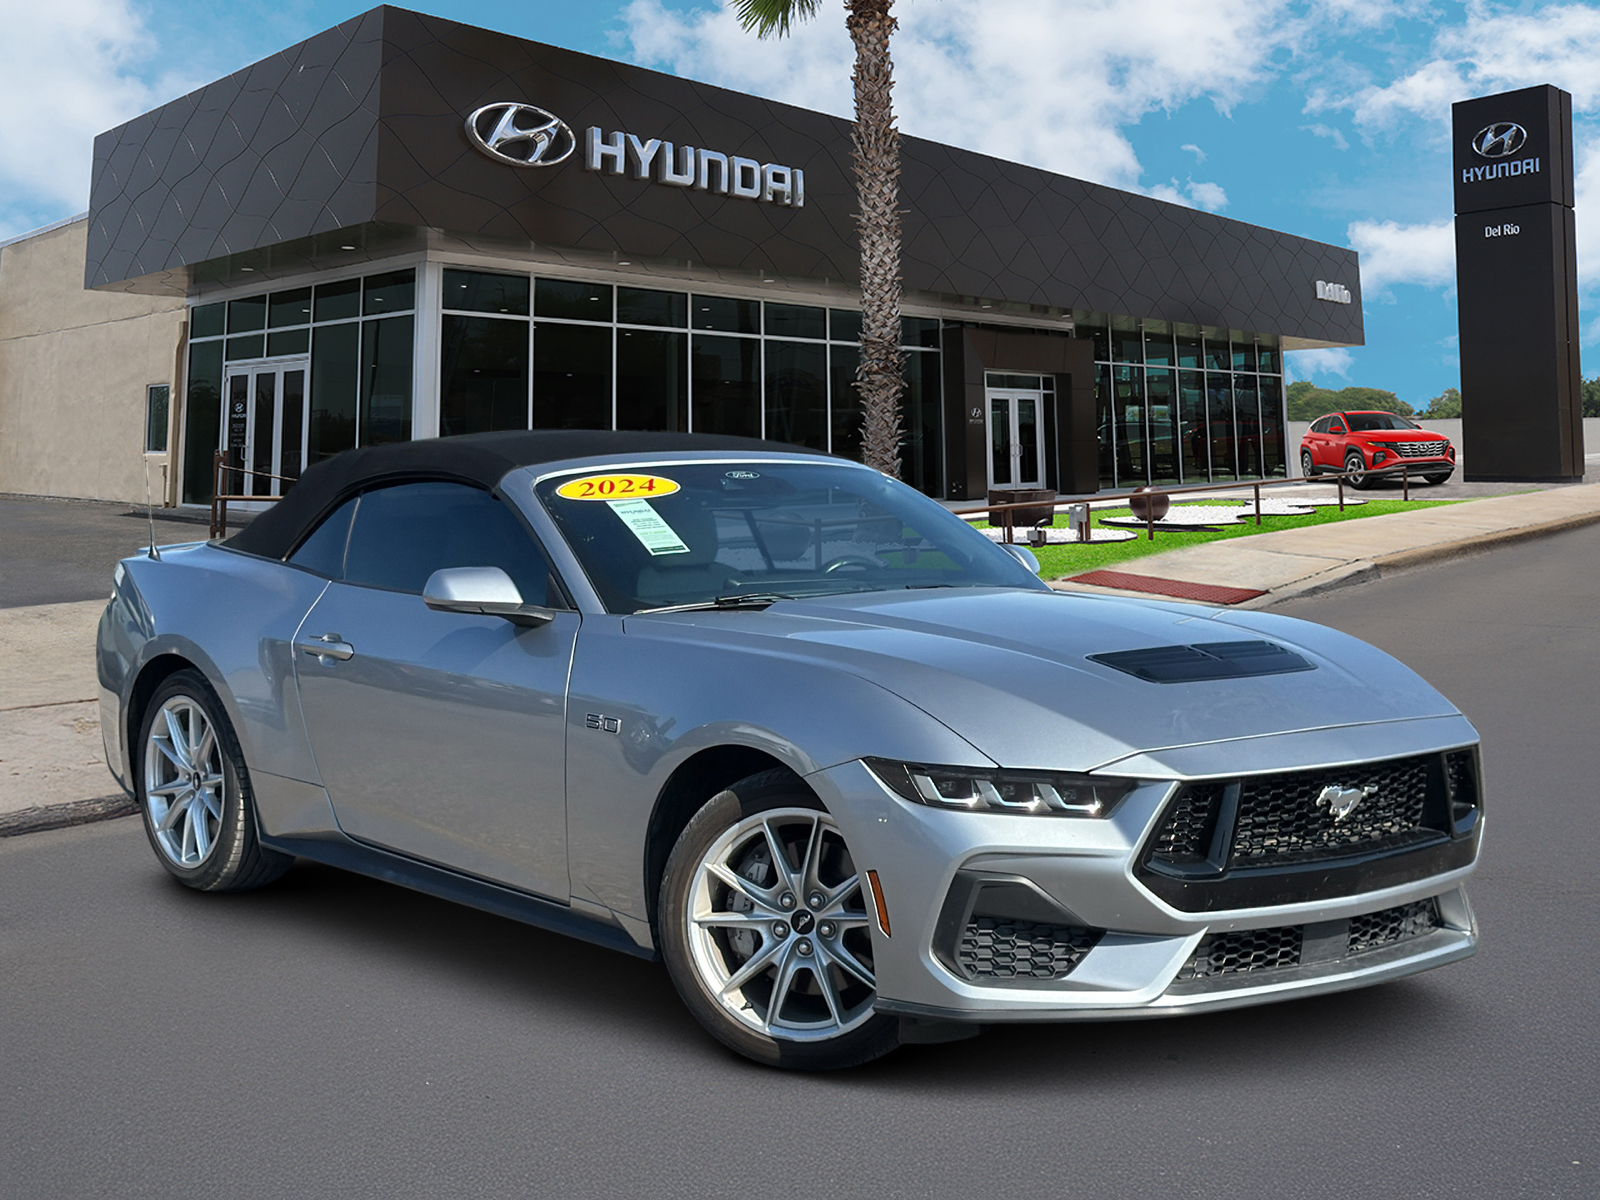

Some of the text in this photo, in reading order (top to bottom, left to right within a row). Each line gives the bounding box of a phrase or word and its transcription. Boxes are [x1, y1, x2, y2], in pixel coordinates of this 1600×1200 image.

[586, 126, 804, 208] HYUNDAI
[1462, 157, 1540, 184] HYUNDAI
[1484, 223, 1520, 238] Del Rio
[579, 478, 656, 497] 2024
